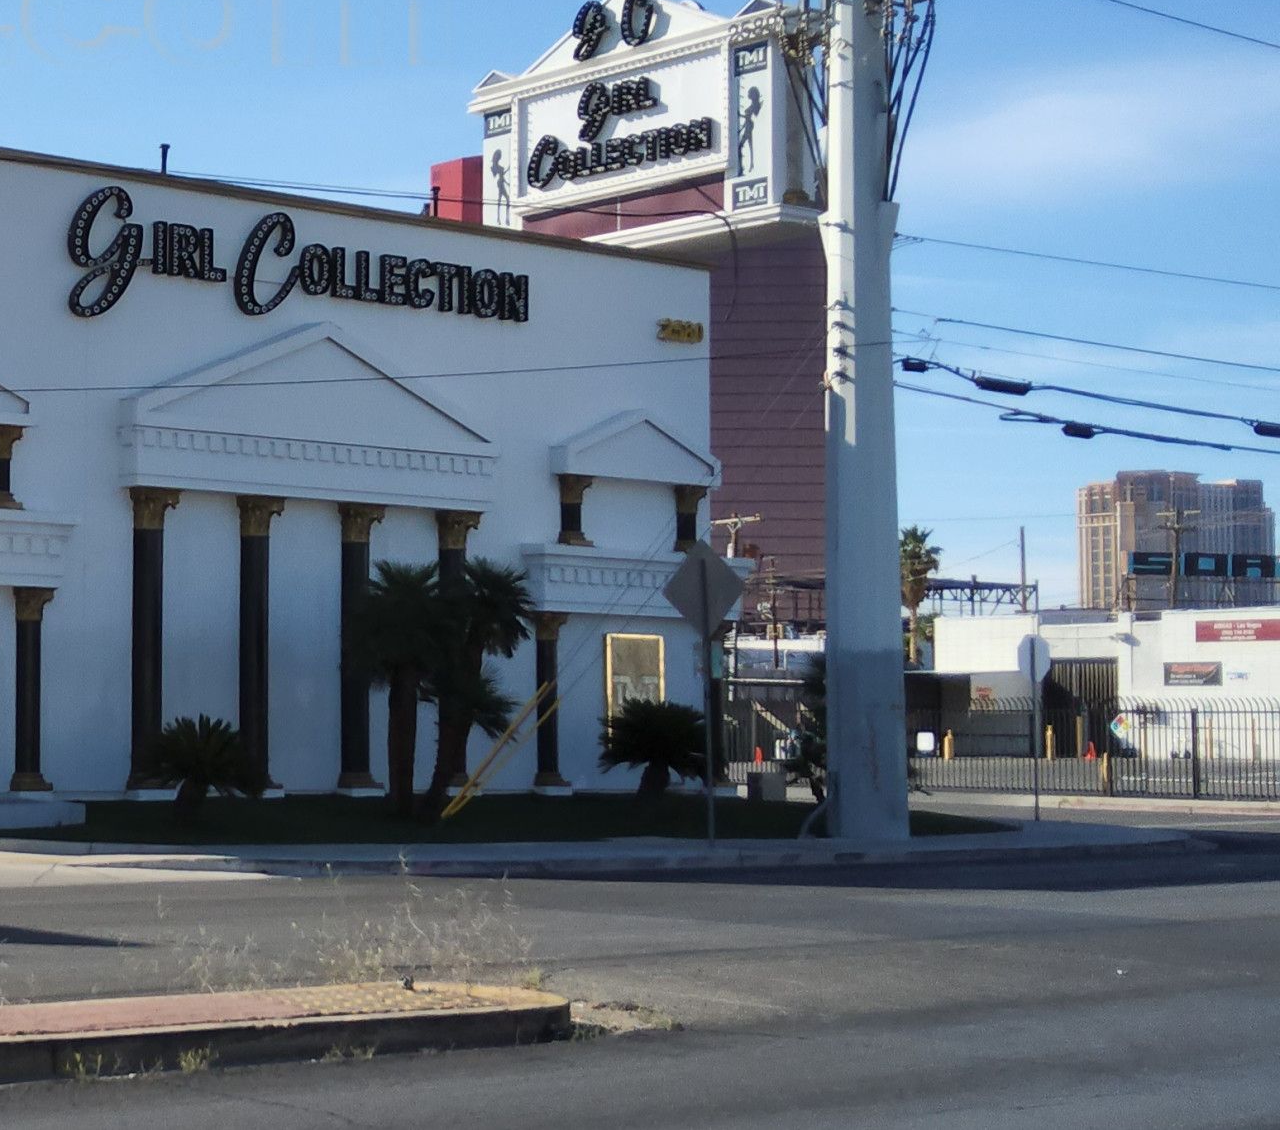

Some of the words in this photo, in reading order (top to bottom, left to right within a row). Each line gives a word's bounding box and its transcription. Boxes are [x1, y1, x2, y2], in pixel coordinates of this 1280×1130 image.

[735, 46, 766, 67] TMT
[527, 117, 713, 189] COLLECTION
[736, 182, 767, 202] TMT
[67, 185, 227, 317] GIRL
[234, 212, 529, 322] COLLECTION
